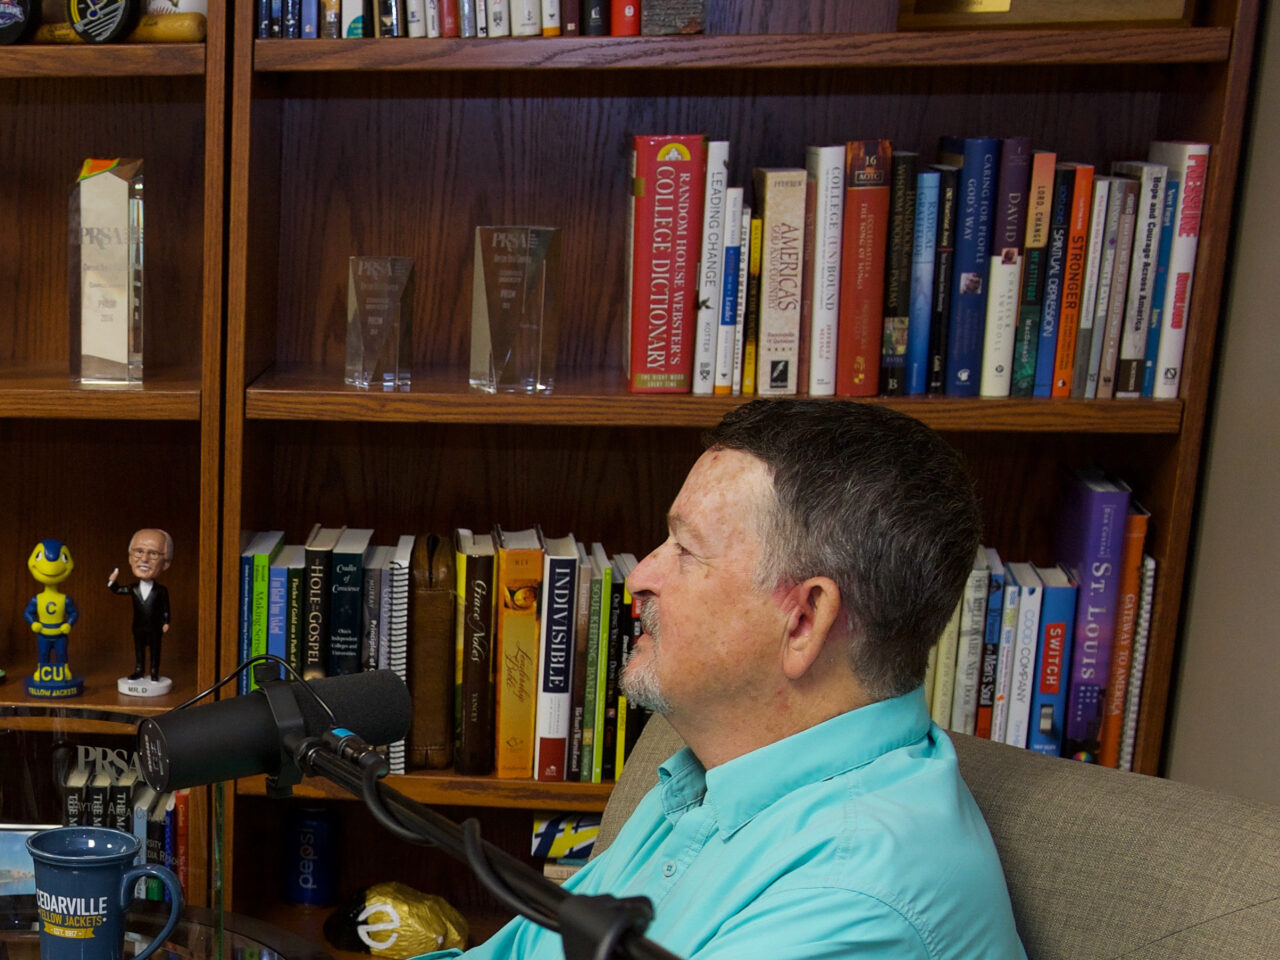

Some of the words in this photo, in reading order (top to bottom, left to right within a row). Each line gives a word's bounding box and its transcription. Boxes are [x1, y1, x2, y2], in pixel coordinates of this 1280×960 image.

[865, 155, 877, 166] 16
[981, 154, 993, 198] CARING
[675, 173, 691, 234] RANDOM
[708, 172, 724, 229] LEADING
[829, 167, 842, 230] COLLEGE
[894, 165, 907, 212] WISDOM
[966, 179, 979, 213] GOD'S
[1034, 186, 1047, 210] LORD,
[1150, 176, 1162, 199] Hope
[651, 166, 676, 254] COLLEGE
[902, 191, 916, 255] HANDBOOK
[925, 202, 938, 250] RADICAL
[979, 201, 990, 221] FOR
[1005, 192, 1022, 242] DAVID
[1031, 212, 1044, 244] CHANGE
[1149, 203, 1158, 219] and
[80, 226, 121, 250] PRSA
[491, 231, 529, 252] PRSA
[771, 225, 781, 245] GOD
[892, 216, 904, 250] BOOKS
[963, 217, 974, 241] WAY
[976, 226, 987, 264] PEOPLE
[1143, 222, 1157, 258] Courage
[673, 240, 688, 287] HOUSE
[705, 233, 720, 287] CHANGE
[770, 247, 779, 266] AND
[777, 223, 800, 312] AMERICA'S
[1047, 229, 1065, 276] SPIRITUAL
[768, 267, 778, 312] COUNTRY
[825, 236, 839, 311] (UN)BOUND
[888, 270, 900, 308] PSALMS
[1027, 265, 1038, 300] ATTITUDE
[1064, 235, 1084, 309] STRONGER
[1140, 262, 1152, 291] Across
[646, 260, 672, 370] DICTIONARY
[994, 294, 1006, 352] SWINDOLL
[1041, 278, 1060, 337] DEPRESSION
[1135, 295, 1148, 331] America
[670, 292, 686, 365] WEBSTER'S
[703, 322, 713, 353] KOTTER
[310, 566, 324, 606] HOLE
[367, 580, 376, 609] MURRAY
[1088, 562, 1112, 597] ST.
[45, 601, 57, 615] C
[253, 591, 265, 627] Making
[471, 579, 488, 622] Grace
[580, 583, 590, 615] Tortured
[590, 584, 601, 613] SOUL
[368, 620, 378, 655] Principles
[548, 567, 572, 688] INDIVISIBLE
[1021, 610, 1036, 645] GOOD
[1120, 593, 1135, 646] GATEWAY
[307, 612, 323, 665] GOSPEL
[467, 616, 487, 665] Notes
[587, 616, 599, 661] KEEPING
[1081, 604, 1106, 679] LOUIS
[41, 666, 64, 682] CU
[369, 657, 378, 666] of
[964, 660, 979, 681] NEXT
[982, 654, 998, 682] Man's
[1045, 628, 1061, 686] SWITCH
[1118, 651, 1129, 665] TO
[28, 687, 52, 697] YELLOW
[53, 686, 77, 696] JACKETS
[128, 685, 141, 694] MR.
[1015, 647, 1032, 704] COMPANY
[1111, 667, 1127, 716] AMERICA
[470, 692, 479, 723] YANCEY
[963, 684, 976, 706] DOOR
[980, 684, 994, 705] Soul
[574, 707, 583, 733] Richard
[76, 745, 146, 784] PRSA
[36, 888, 108, 916] CEDARVILLE
[38, 907, 63, 925] YELLOW
[64, 915, 103, 927] JACKETS
